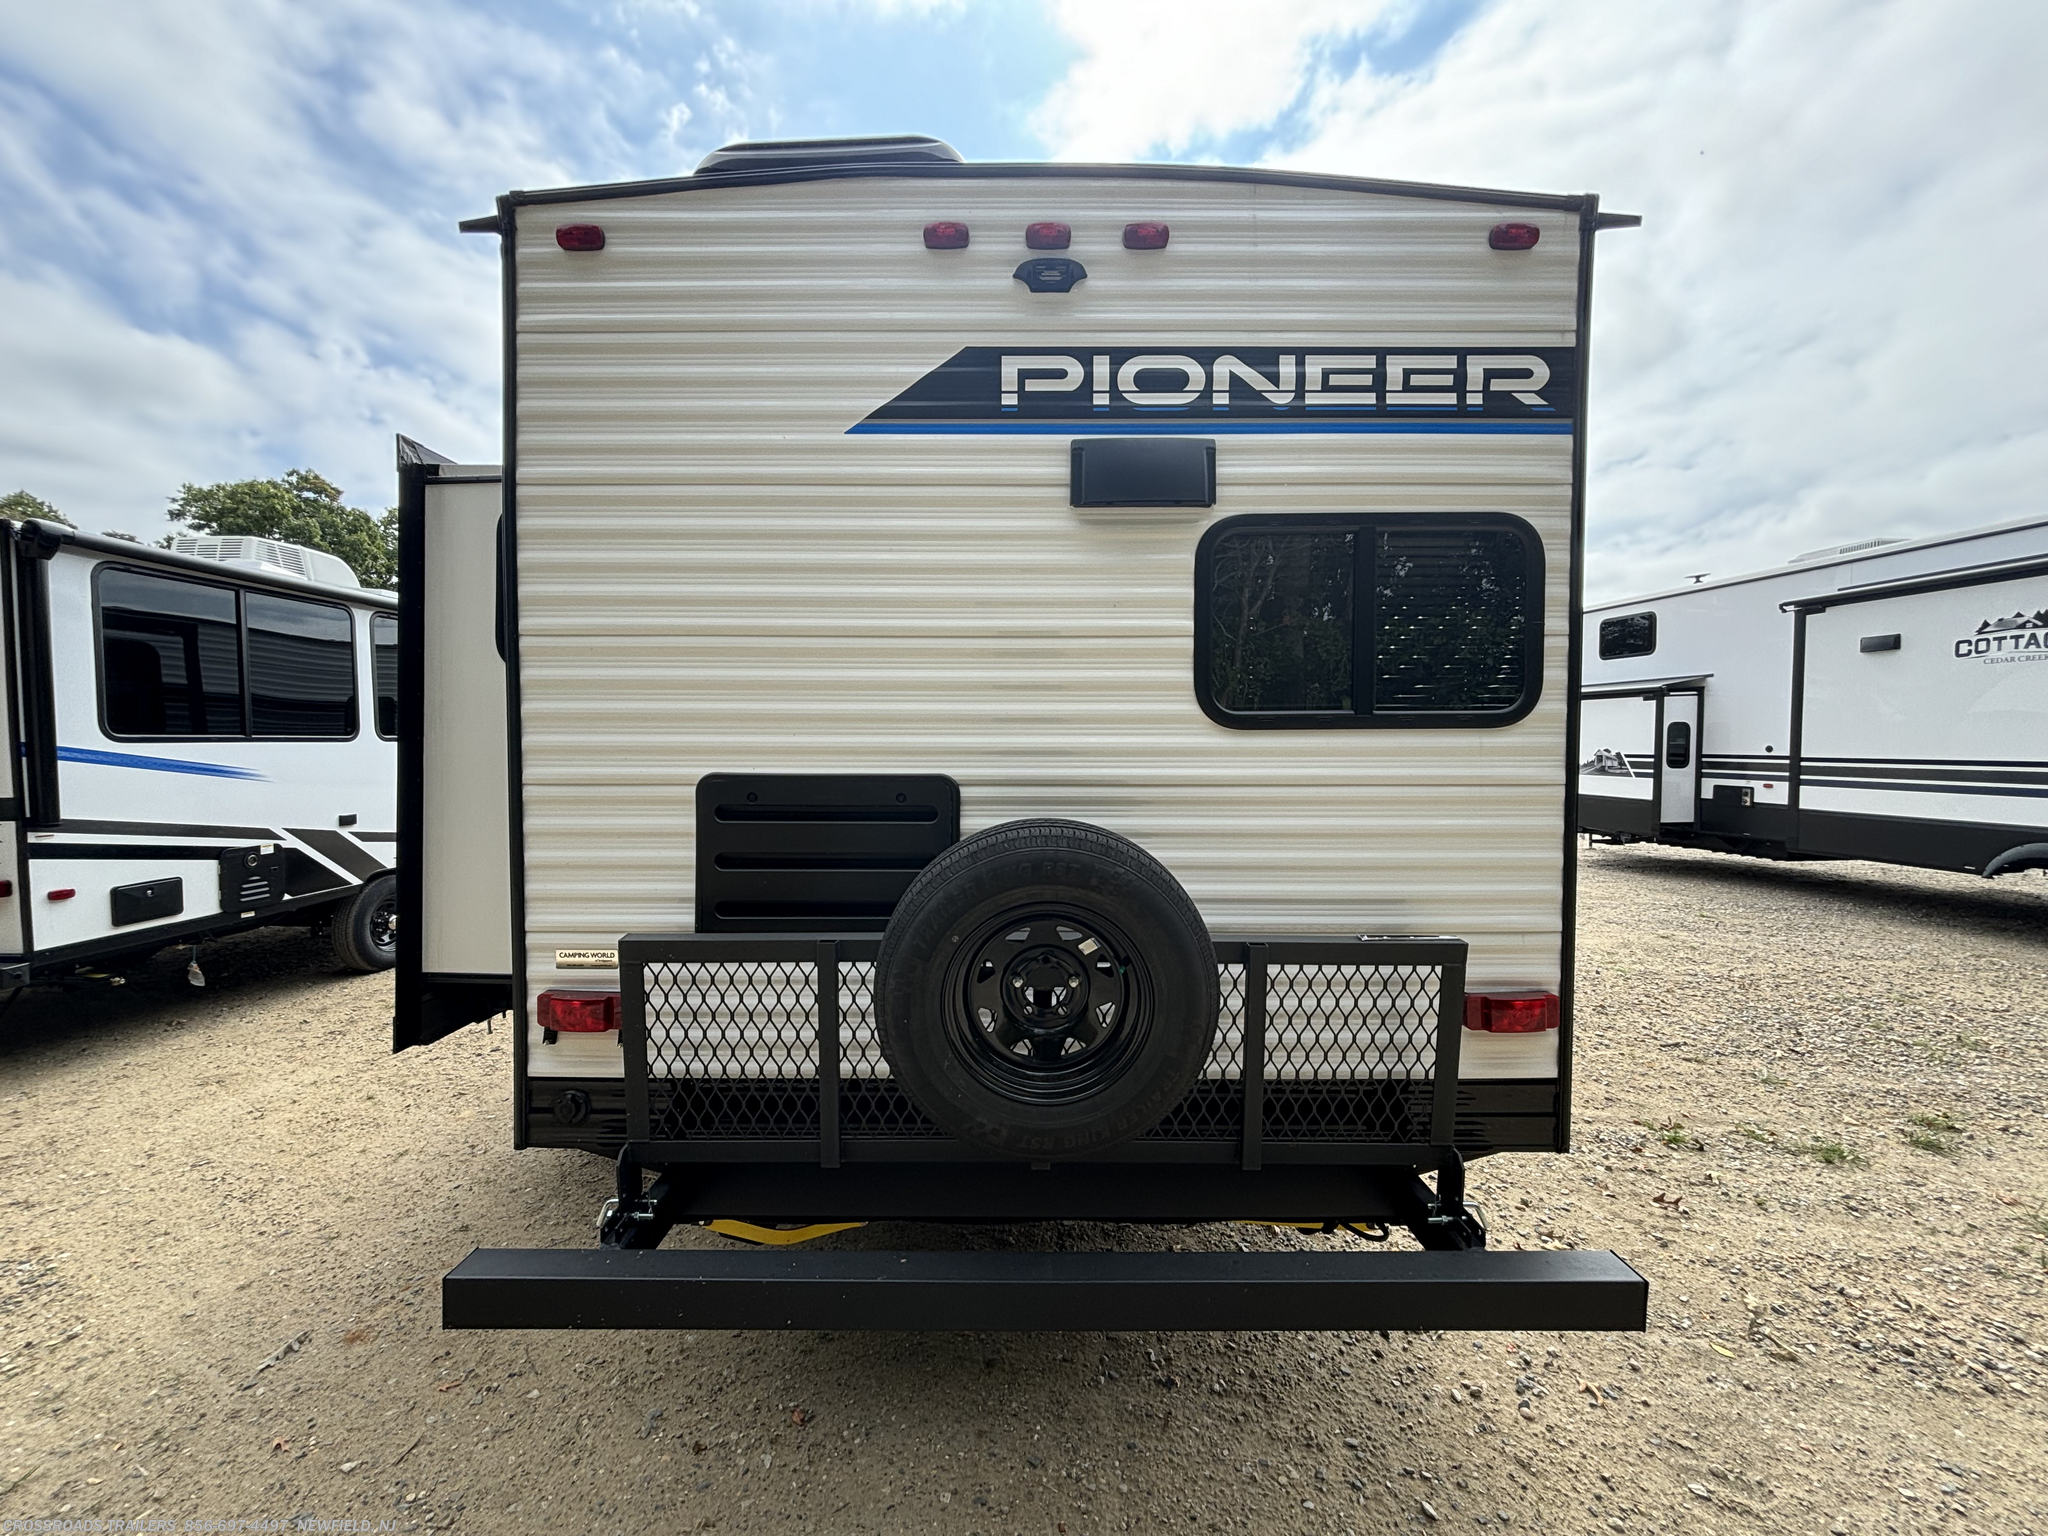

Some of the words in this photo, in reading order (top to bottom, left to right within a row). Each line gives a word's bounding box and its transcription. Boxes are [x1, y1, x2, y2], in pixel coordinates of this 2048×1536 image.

[1000, 355, 1553, 410] PIONEER
[1954, 632, 2048, 658] COTTA
[1983, 655, 2016, 665] CEDAR
